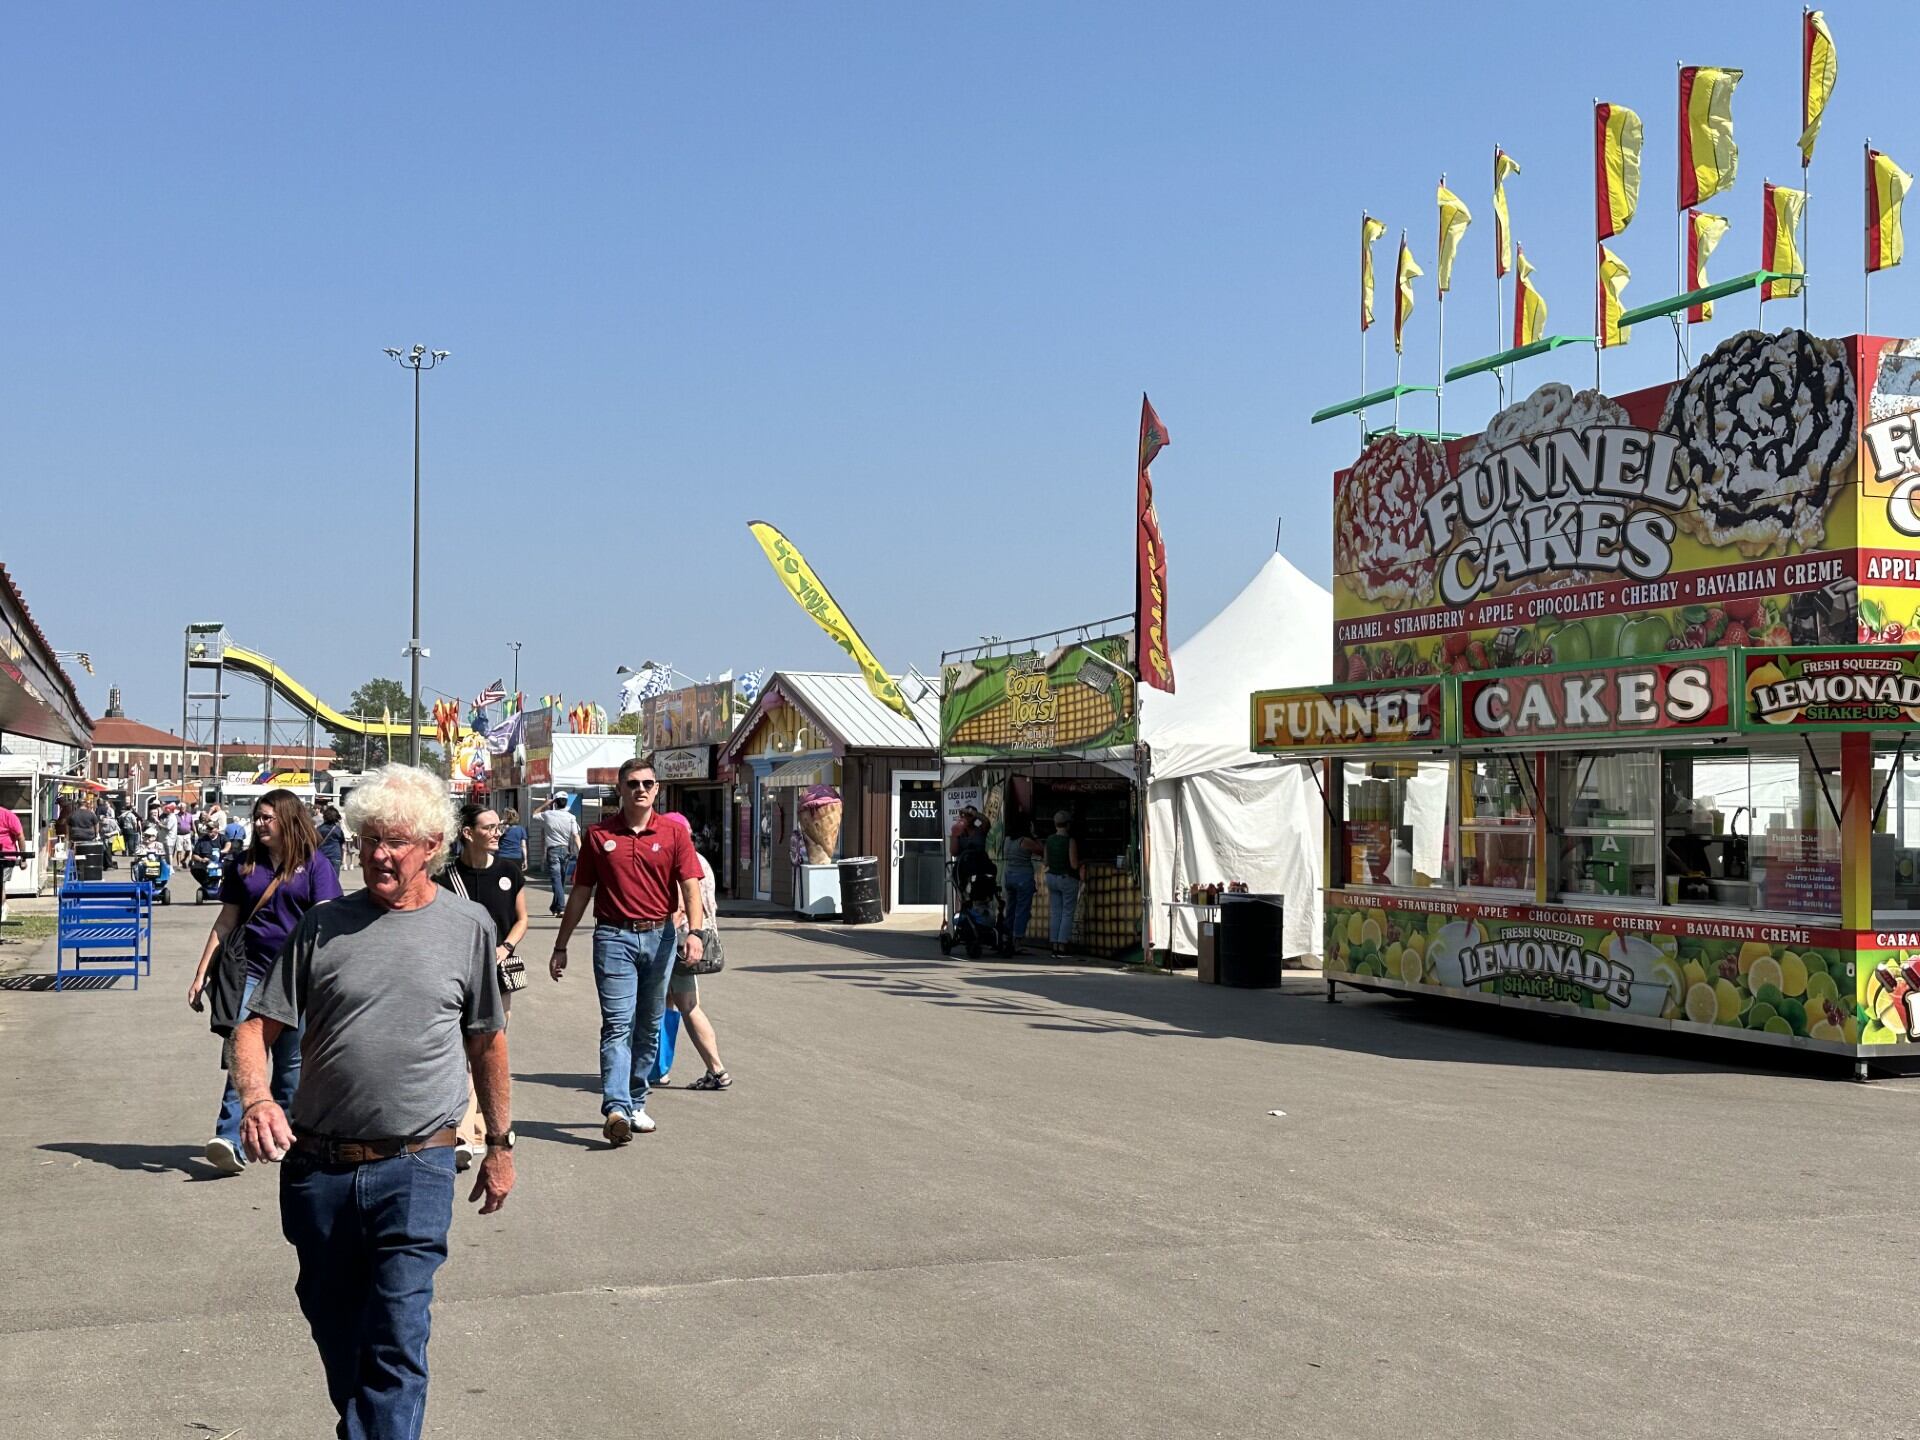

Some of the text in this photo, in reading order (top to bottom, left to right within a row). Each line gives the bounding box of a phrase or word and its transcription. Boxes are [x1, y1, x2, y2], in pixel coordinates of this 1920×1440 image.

[1421, 425, 1690, 553] FUNNEL
[1440, 501, 1677, 606] CAKES
[1338, 559, 1843, 641] CARAMEL STRAWBERRY APPLE CHOCOLATE CHERRY BAVARIAN CREME
[1006, 667, 1052, 700] Corn
[1803, 658, 1902, 673] FRESH SQUEEZED
[1008, 692, 1058, 731] Roast
[1263, 665, 1714, 741] FUNNEL CAKES
[1805, 706, 1900, 720] SHAKE-UPS
[909, 809, 938, 818] ONLY
[911, 800, 936, 809] EXIT
[1343, 895, 1811, 944] CARAMEL STRAWBERRY APPLE CHOCOLATE CHERRY BAVARIAN CREME
[1500, 927, 1585, 947] FRESH SQUEEZED
[1459, 938, 1635, 1008] LEMONADE
[1503, 975, 1582, 1002] SHAKE-UPS
